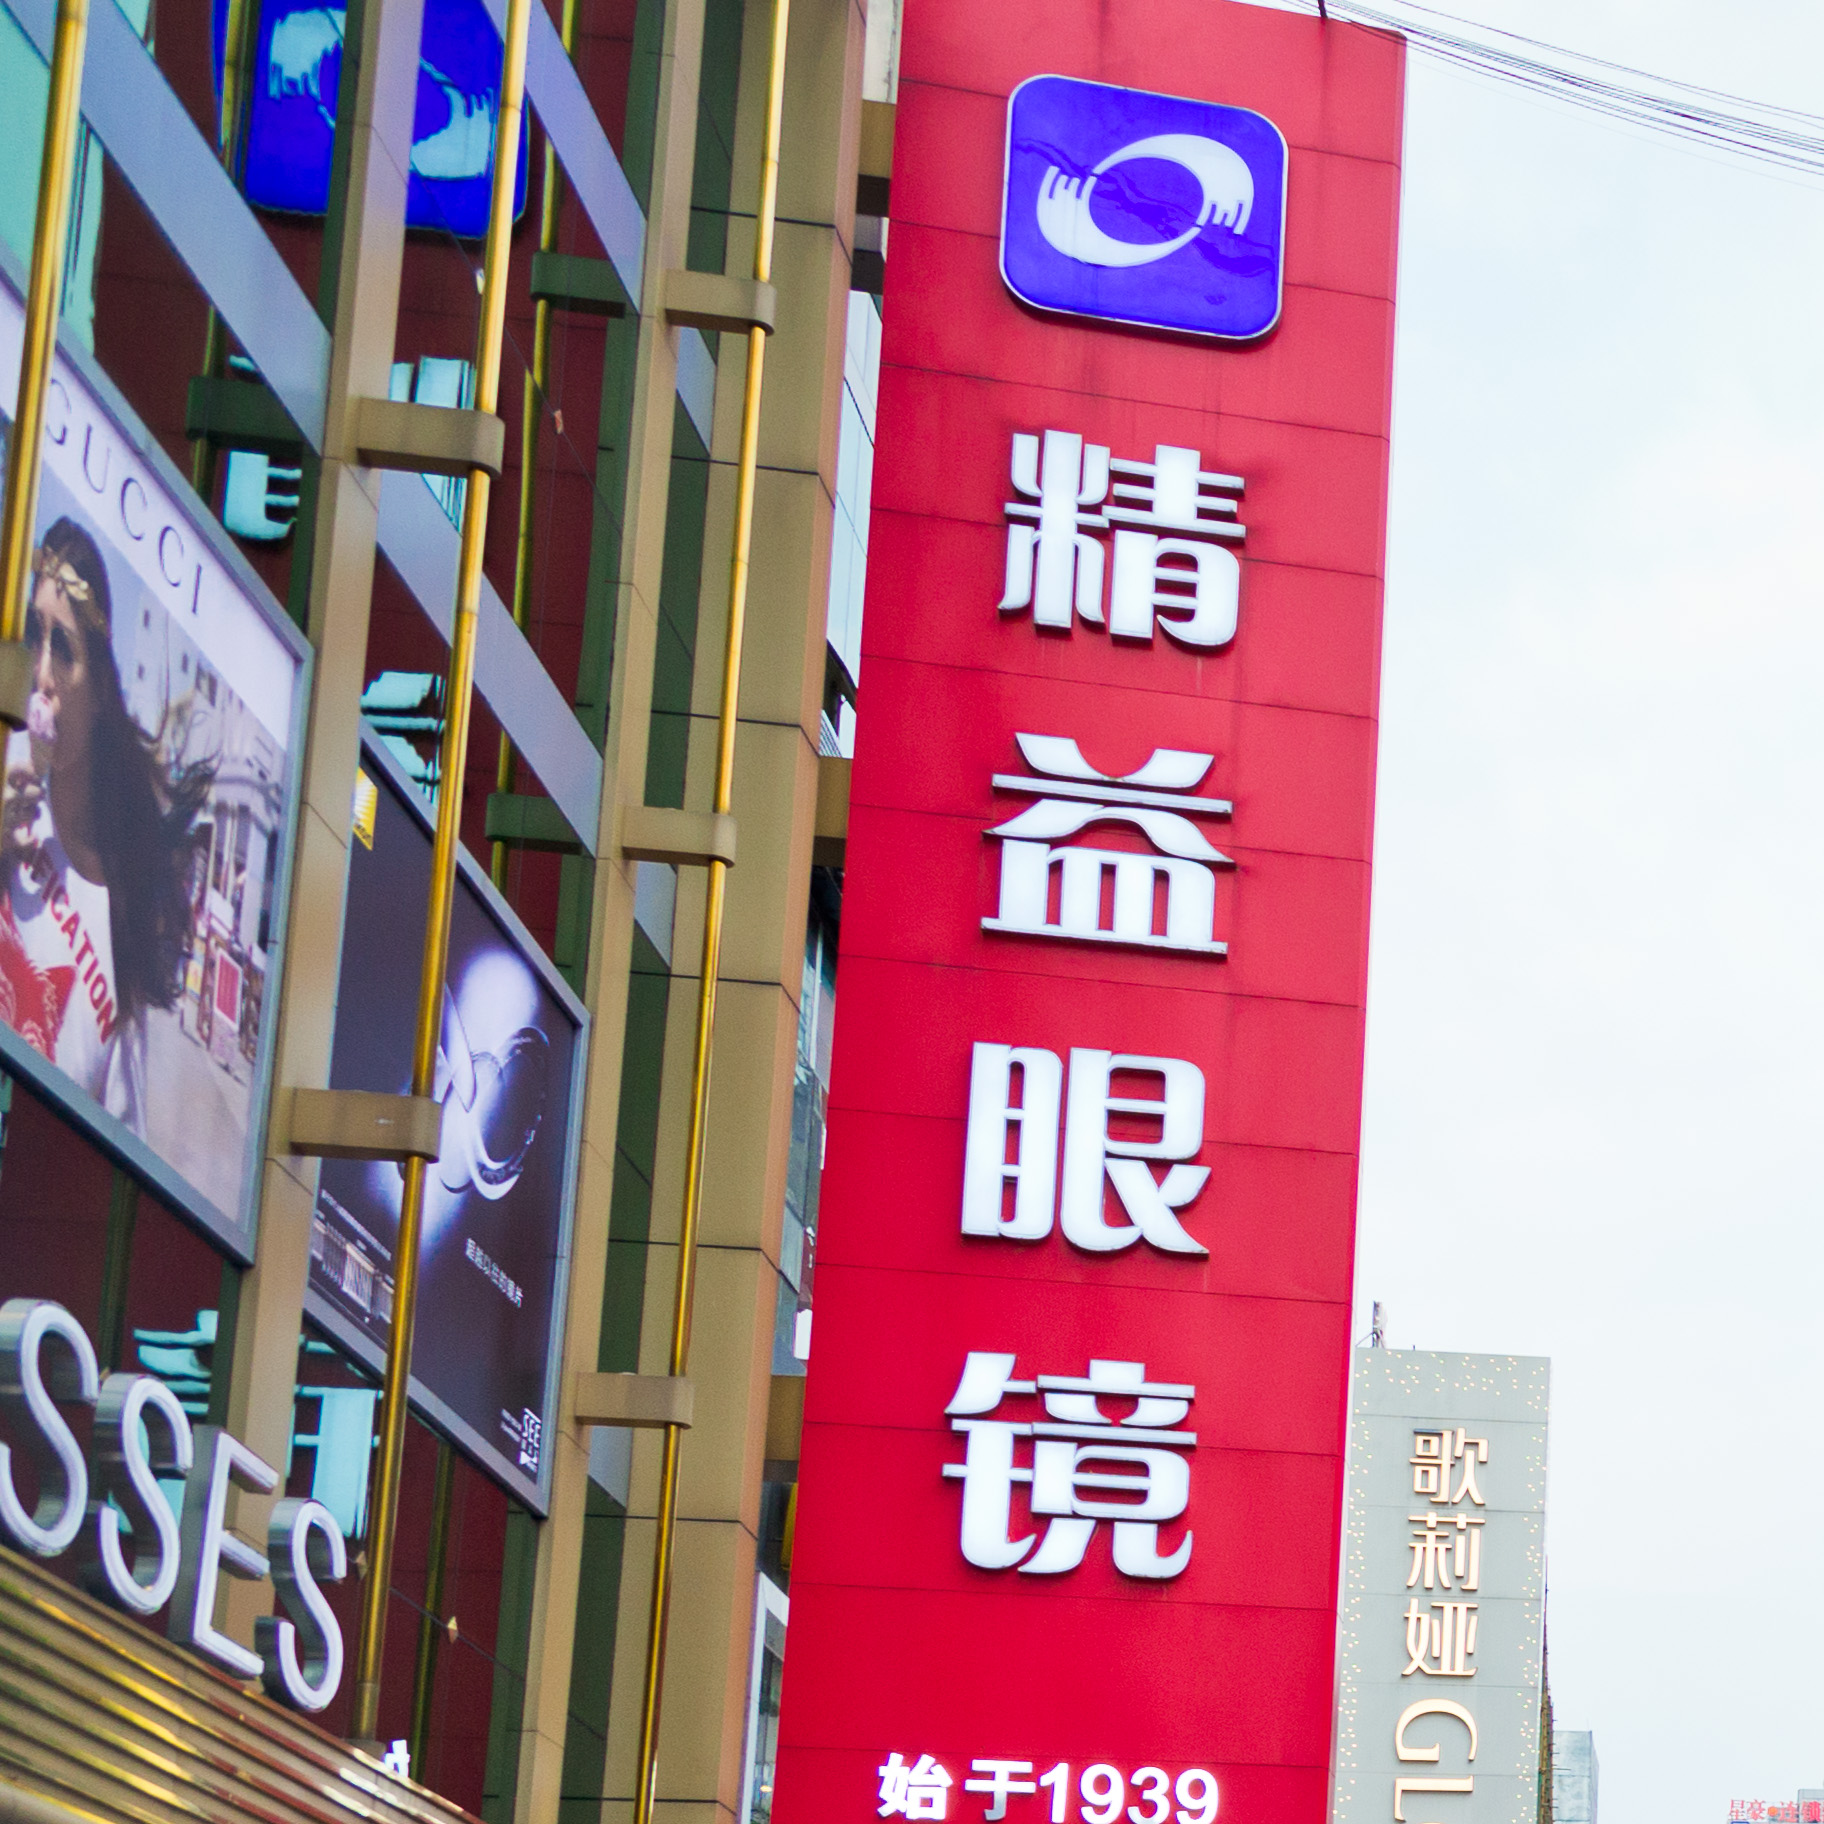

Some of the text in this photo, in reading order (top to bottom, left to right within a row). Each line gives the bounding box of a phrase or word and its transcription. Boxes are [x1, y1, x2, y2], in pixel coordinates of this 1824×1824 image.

[942, 430, 1245, 1578] 精益眼镜
[1402, 1428, 1489, 1678] 歌莉娅
